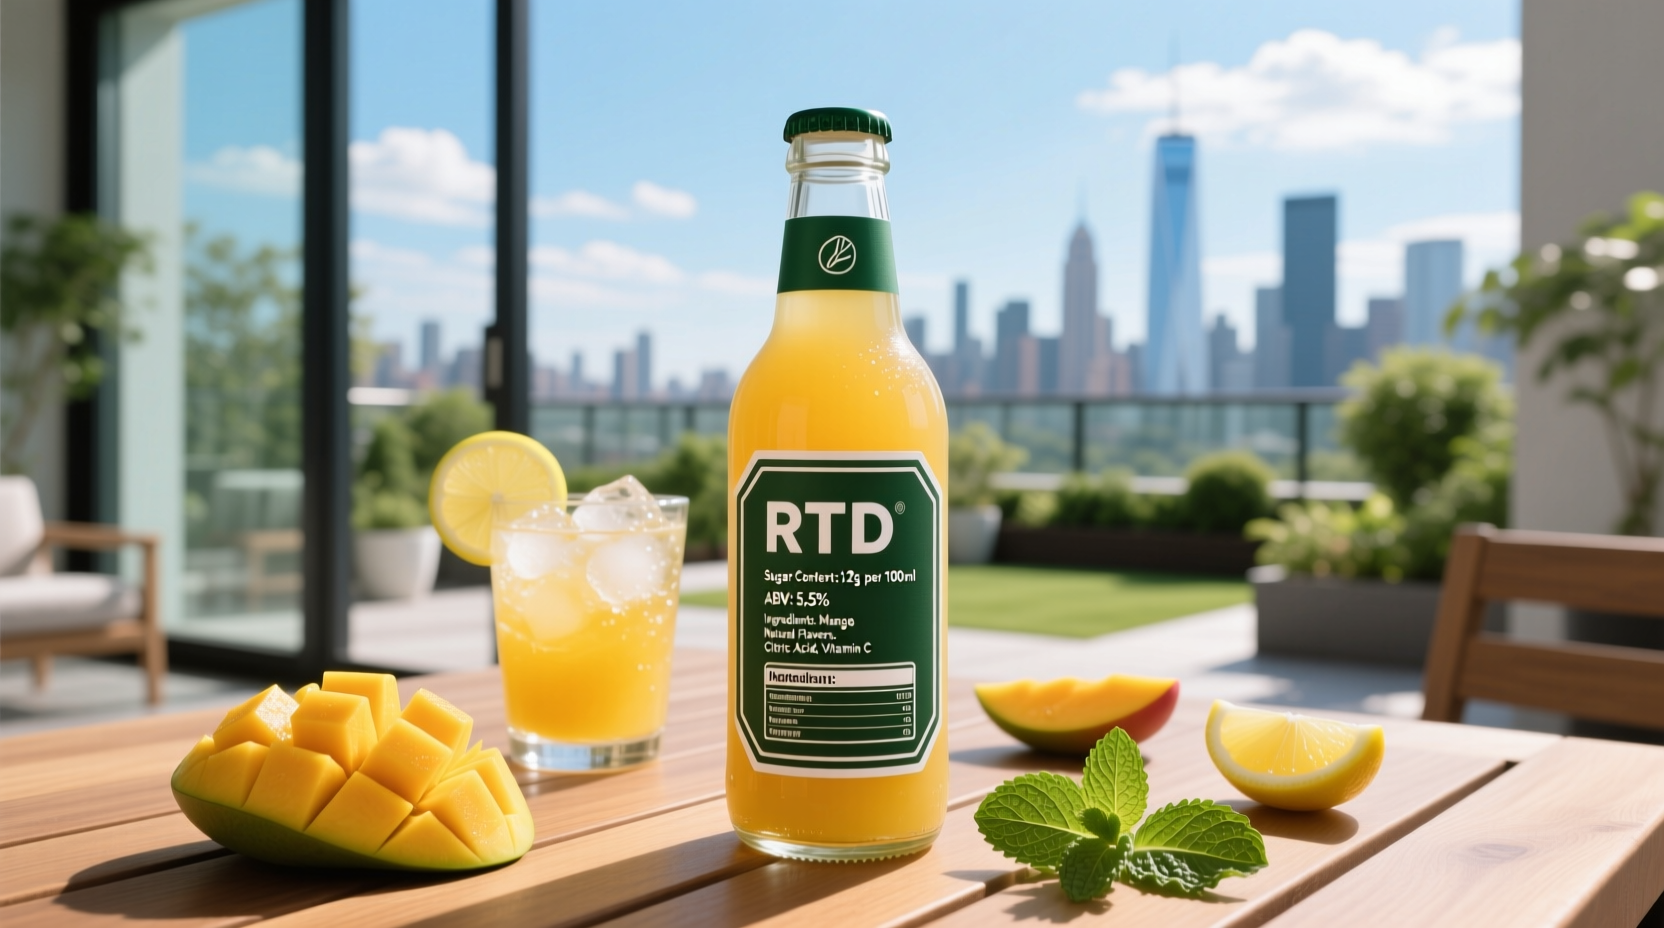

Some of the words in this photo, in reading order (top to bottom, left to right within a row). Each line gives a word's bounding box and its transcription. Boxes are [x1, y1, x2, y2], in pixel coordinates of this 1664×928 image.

[766, 501, 894, 555] RTD
[864, 572, 882, 587] per
[884, 569, 916, 583] 100ml
[863, 641, 872, 654] C
